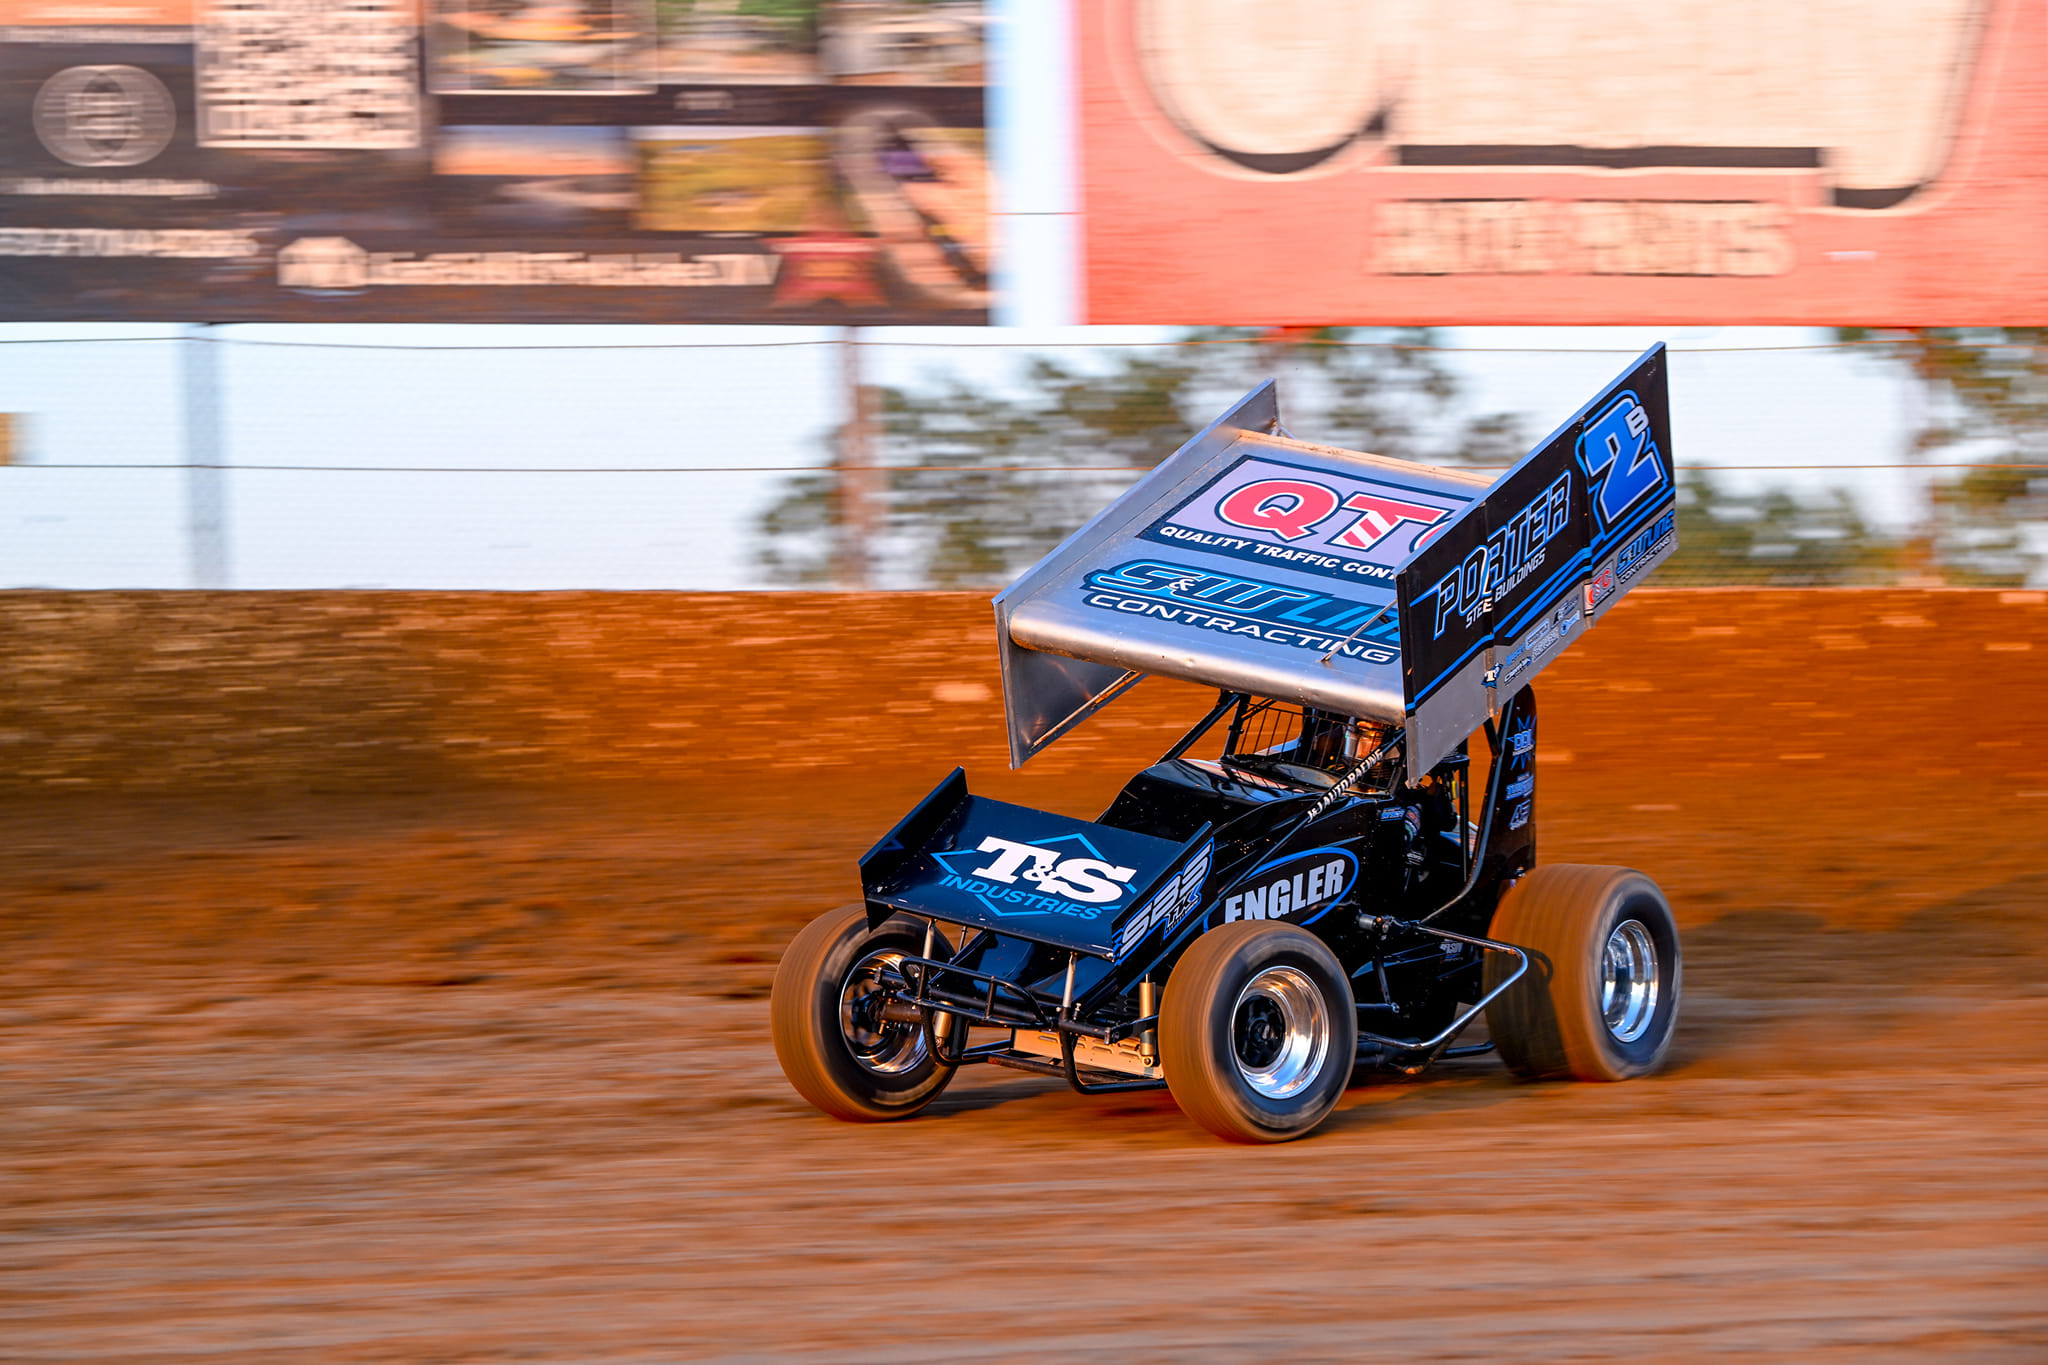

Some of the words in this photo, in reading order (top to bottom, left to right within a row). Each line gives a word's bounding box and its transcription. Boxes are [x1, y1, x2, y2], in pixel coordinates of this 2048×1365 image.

[1160, 525, 1252, 551] QUALITY
[1254, 543, 1340, 569] TRAFFIC
[1215, 478, 1452, 553] QT
[1434, 470, 1571, 640] PORTER
[1465, 598, 1493, 629] STEE
[1495, 548, 1546, 602] BUILDINGS
[1090, 594, 1395, 662] CONTRACTING
[939, 875, 1102, 920] INDUSTRIES
[971, 836, 1137, 903] T&S
[1225, 859, 1345, 924] ENGLER
